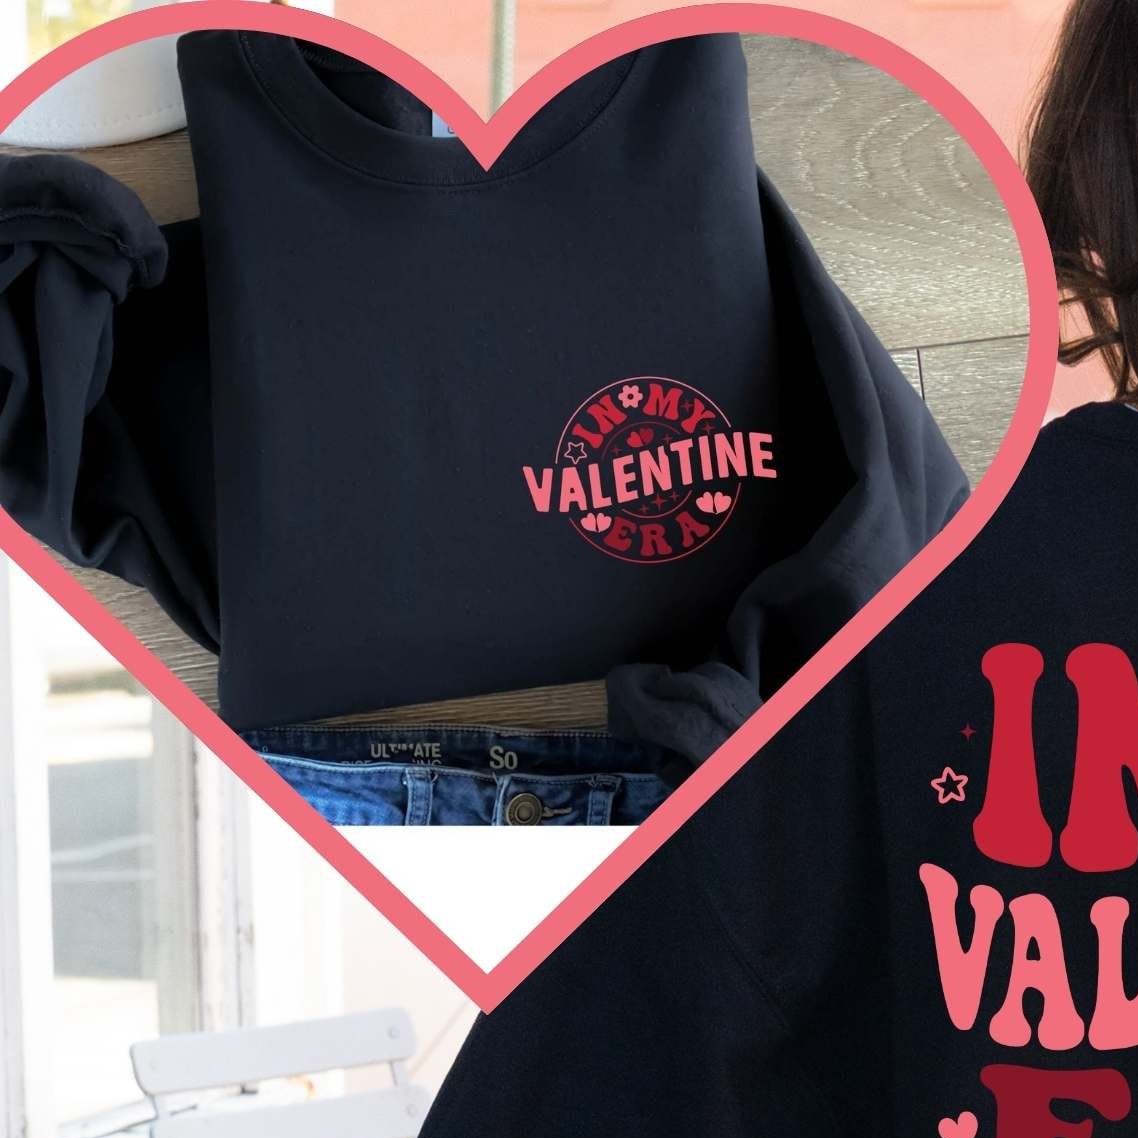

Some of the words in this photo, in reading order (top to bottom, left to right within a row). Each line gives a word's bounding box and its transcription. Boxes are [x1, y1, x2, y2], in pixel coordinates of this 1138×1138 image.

[572, 394, 627, 448] IN
[643, 384, 716, 433] MY
[522, 432, 777, 513] VALENTINE
[603, 511, 710, 556] ERA
[489, 745, 518, 770] So
